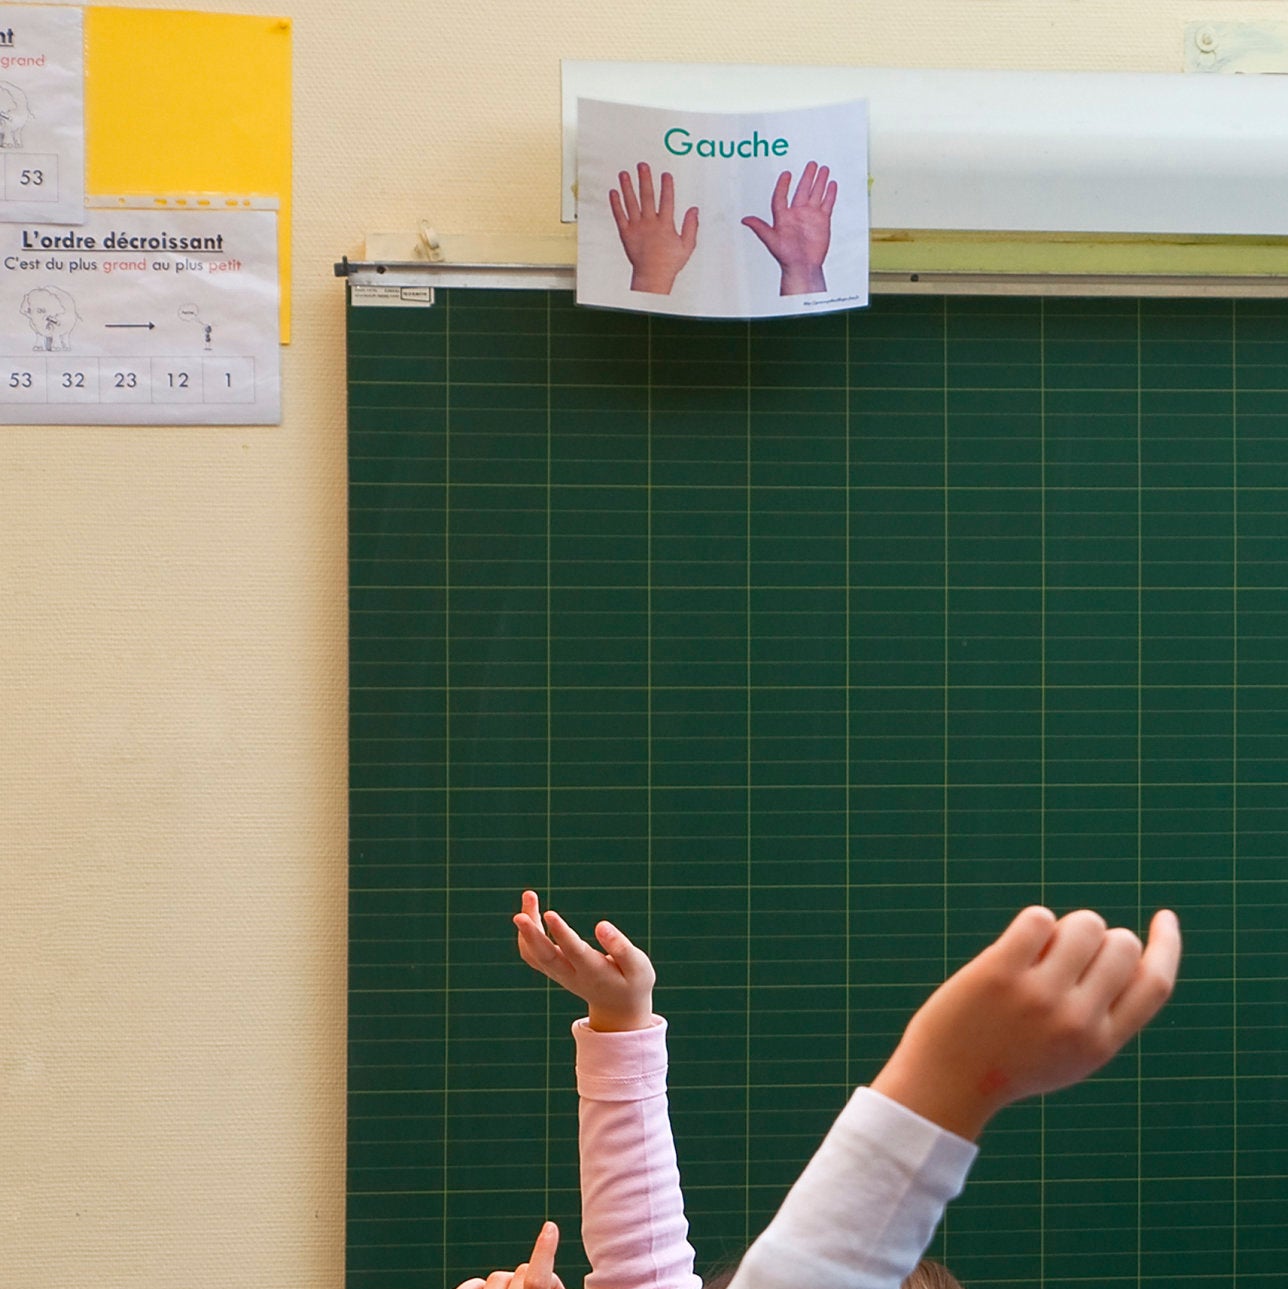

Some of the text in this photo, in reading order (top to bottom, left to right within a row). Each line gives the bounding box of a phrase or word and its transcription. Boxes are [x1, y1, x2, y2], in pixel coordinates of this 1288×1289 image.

[0, 54, 46, 70] grand
[663, 127, 790, 159] Gauche
[19, 169, 44, 186] 53
[22, 229, 224, 253] L'ordre décroissant
[4, 257, 243, 276] C'est du plus grand au plus petit
[8, 373, 33, 388] 53
[61, 373, 86, 388] 32
[114, 373, 138, 388] 23
[166, 373, 190, 388] 12
[224, 373, 233, 388] 1
